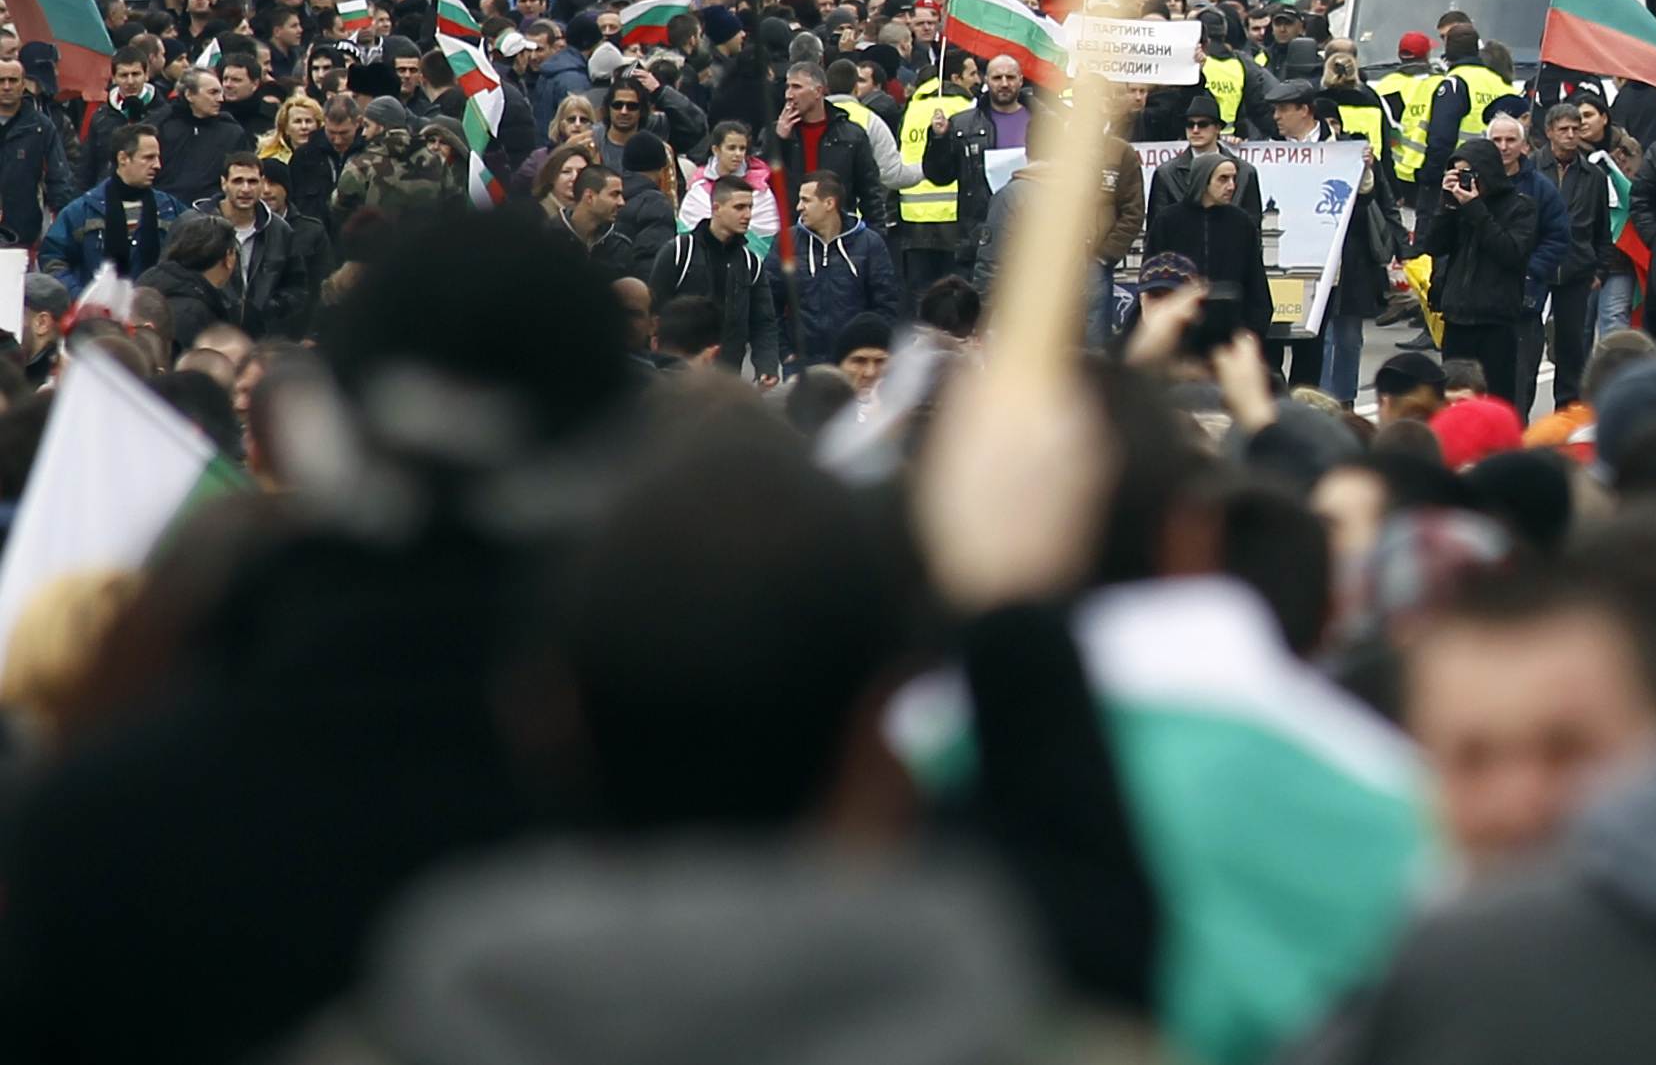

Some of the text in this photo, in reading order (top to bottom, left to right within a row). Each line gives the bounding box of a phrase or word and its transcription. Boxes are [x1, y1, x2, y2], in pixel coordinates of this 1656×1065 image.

[1093, 23, 1155, 38] ПАРТИИТЕ
[1103, 41, 1172, 57] ДЪРЖАВНИ
[1238, 146, 1312, 165] ЛГАРИЯ
